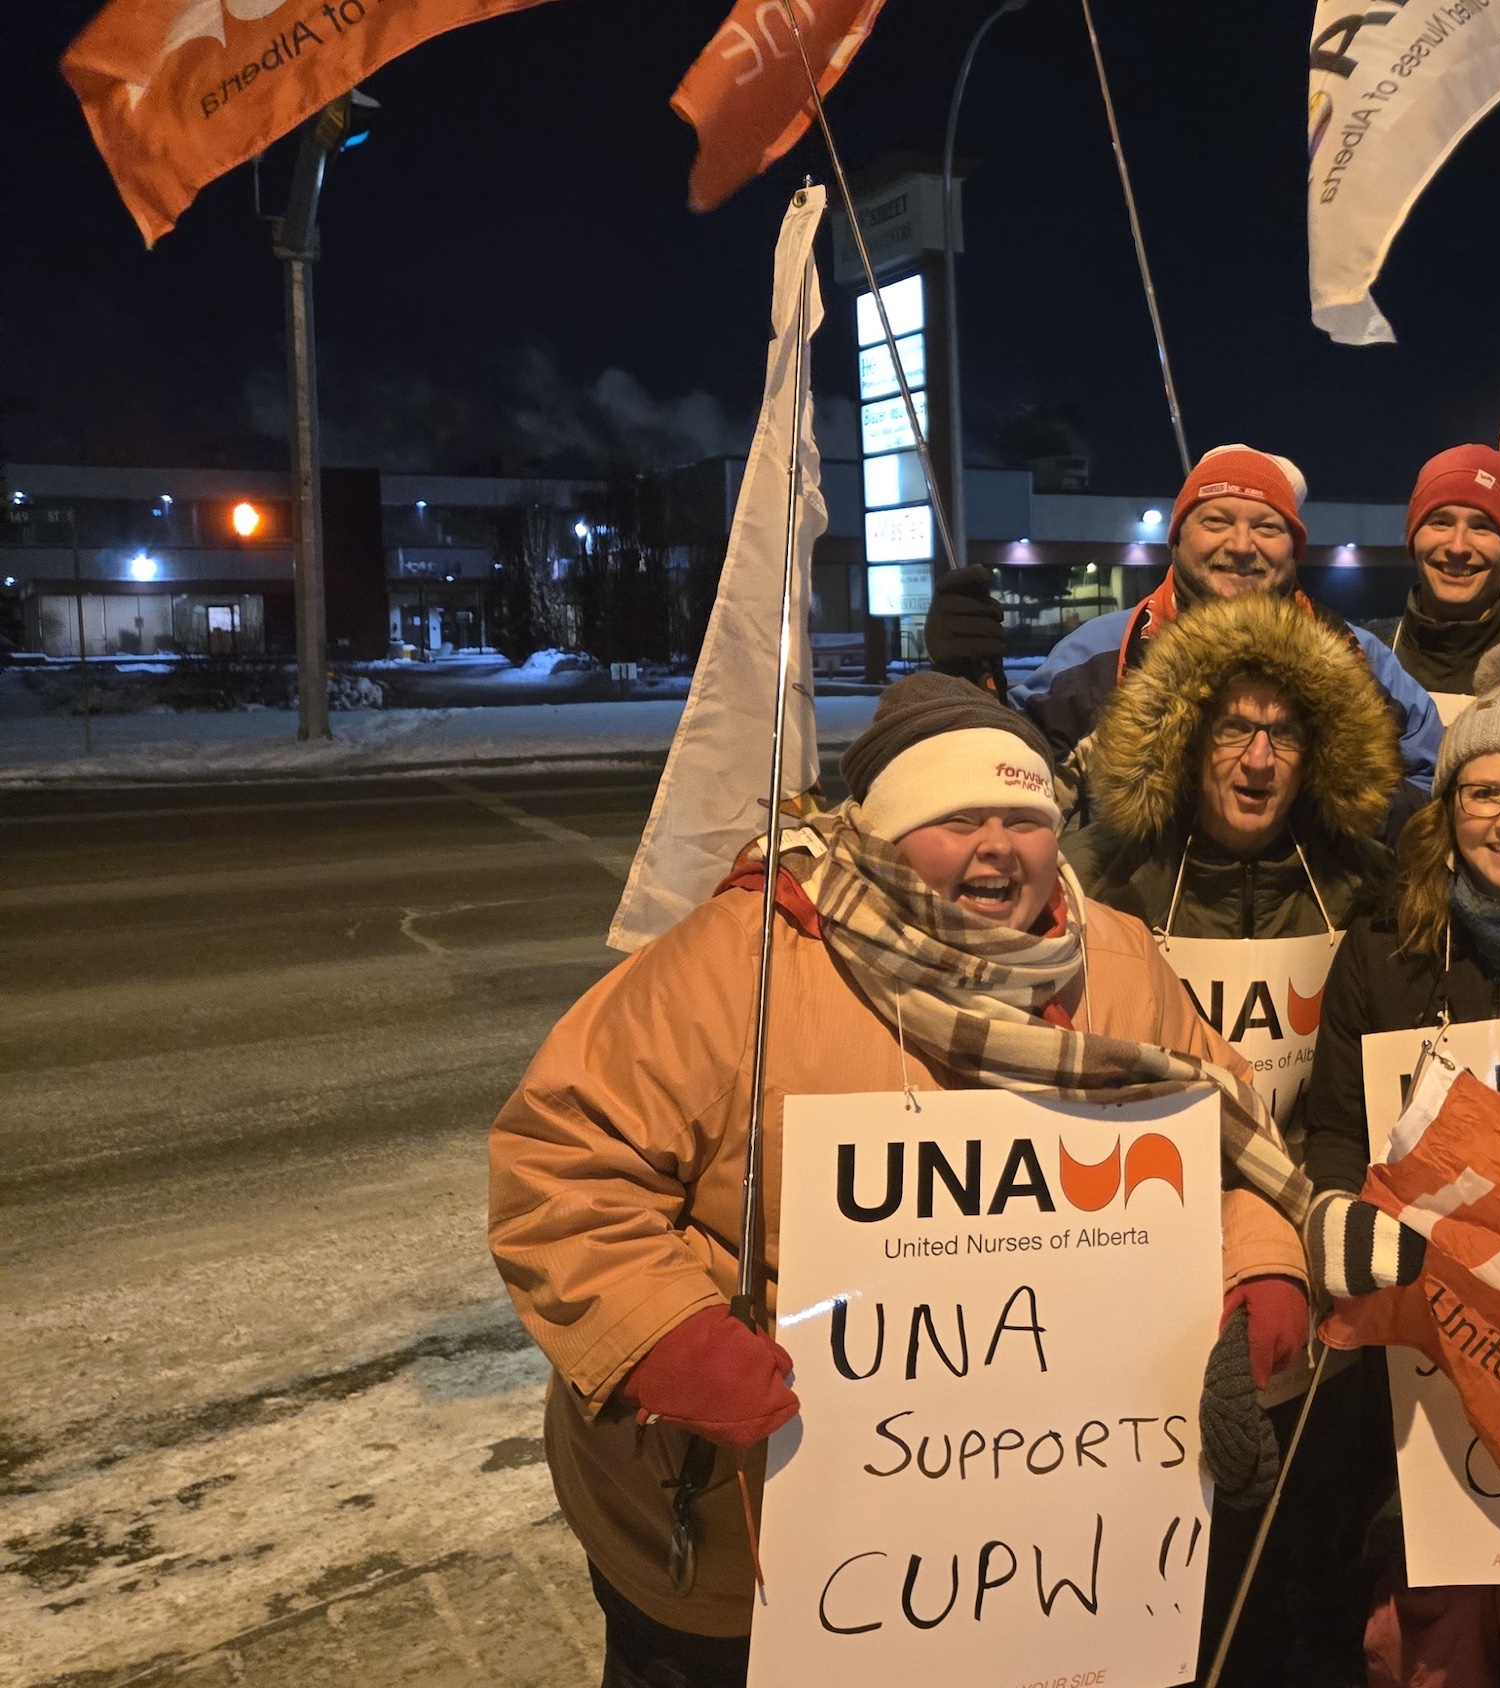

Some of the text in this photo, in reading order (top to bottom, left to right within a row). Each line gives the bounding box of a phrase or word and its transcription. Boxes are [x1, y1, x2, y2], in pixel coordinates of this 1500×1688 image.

[1179, 978, 1284, 1043] NA
[1278, 1054, 1291, 1069] of
[836, 1139, 1056, 1223] UNA
[885, 1227, 1149, 1259] United Nurses of Alberta
[830, 1285, 1048, 1381] UNA
[863, 1410, 1188, 1480] SUPPORTS
[819, 1513, 1103, 1634] CUPW
[1070, 1669, 1107, 1688] SIDE
